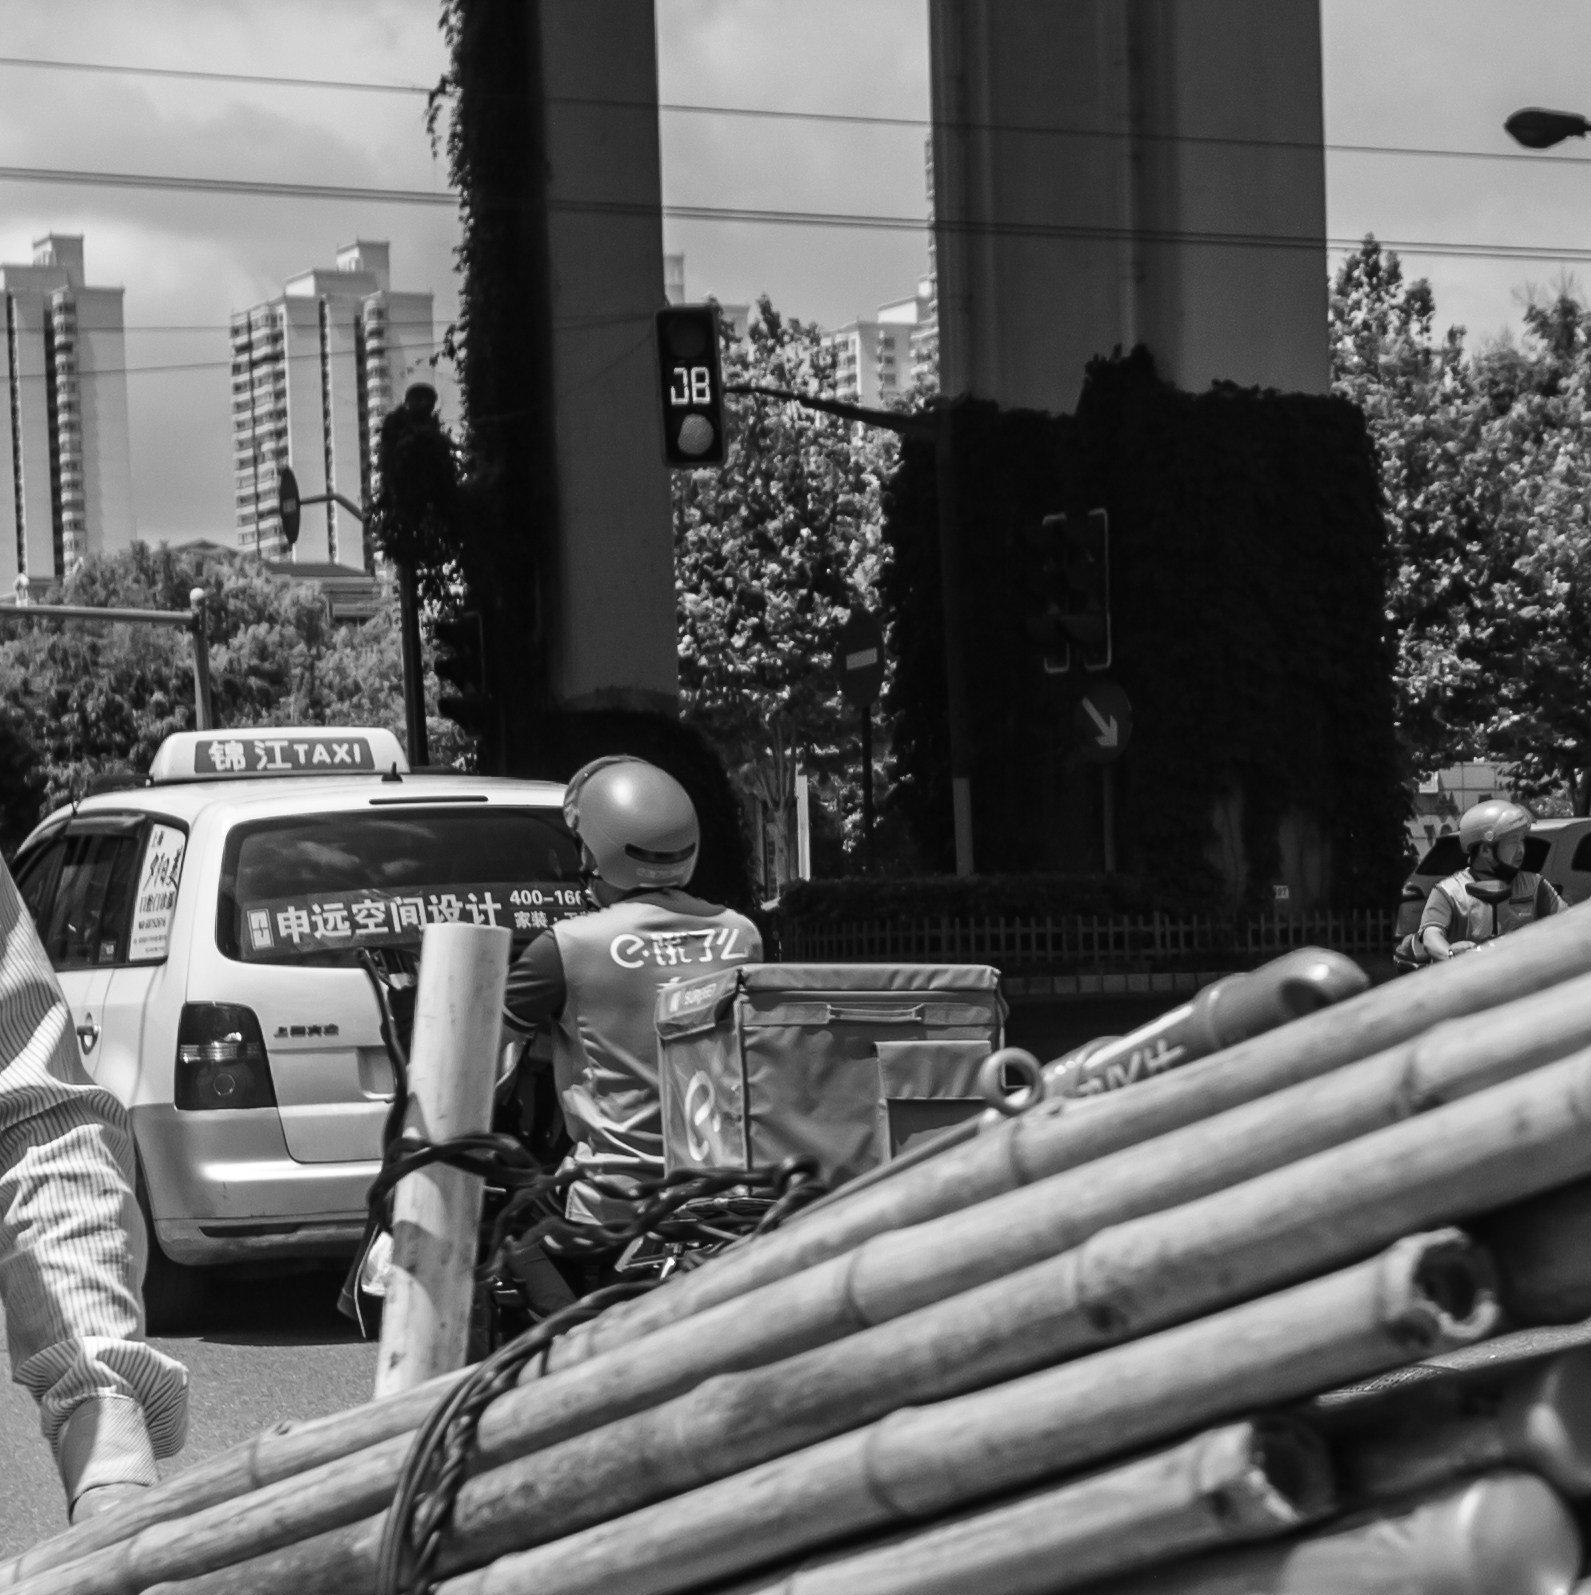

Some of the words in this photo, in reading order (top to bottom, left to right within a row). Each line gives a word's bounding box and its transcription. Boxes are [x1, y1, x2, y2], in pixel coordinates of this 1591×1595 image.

[209, 740, 292, 771] 锦江
[293, 743, 361, 764] TAXI
[276, 892, 502, 943] 申远空间设计
